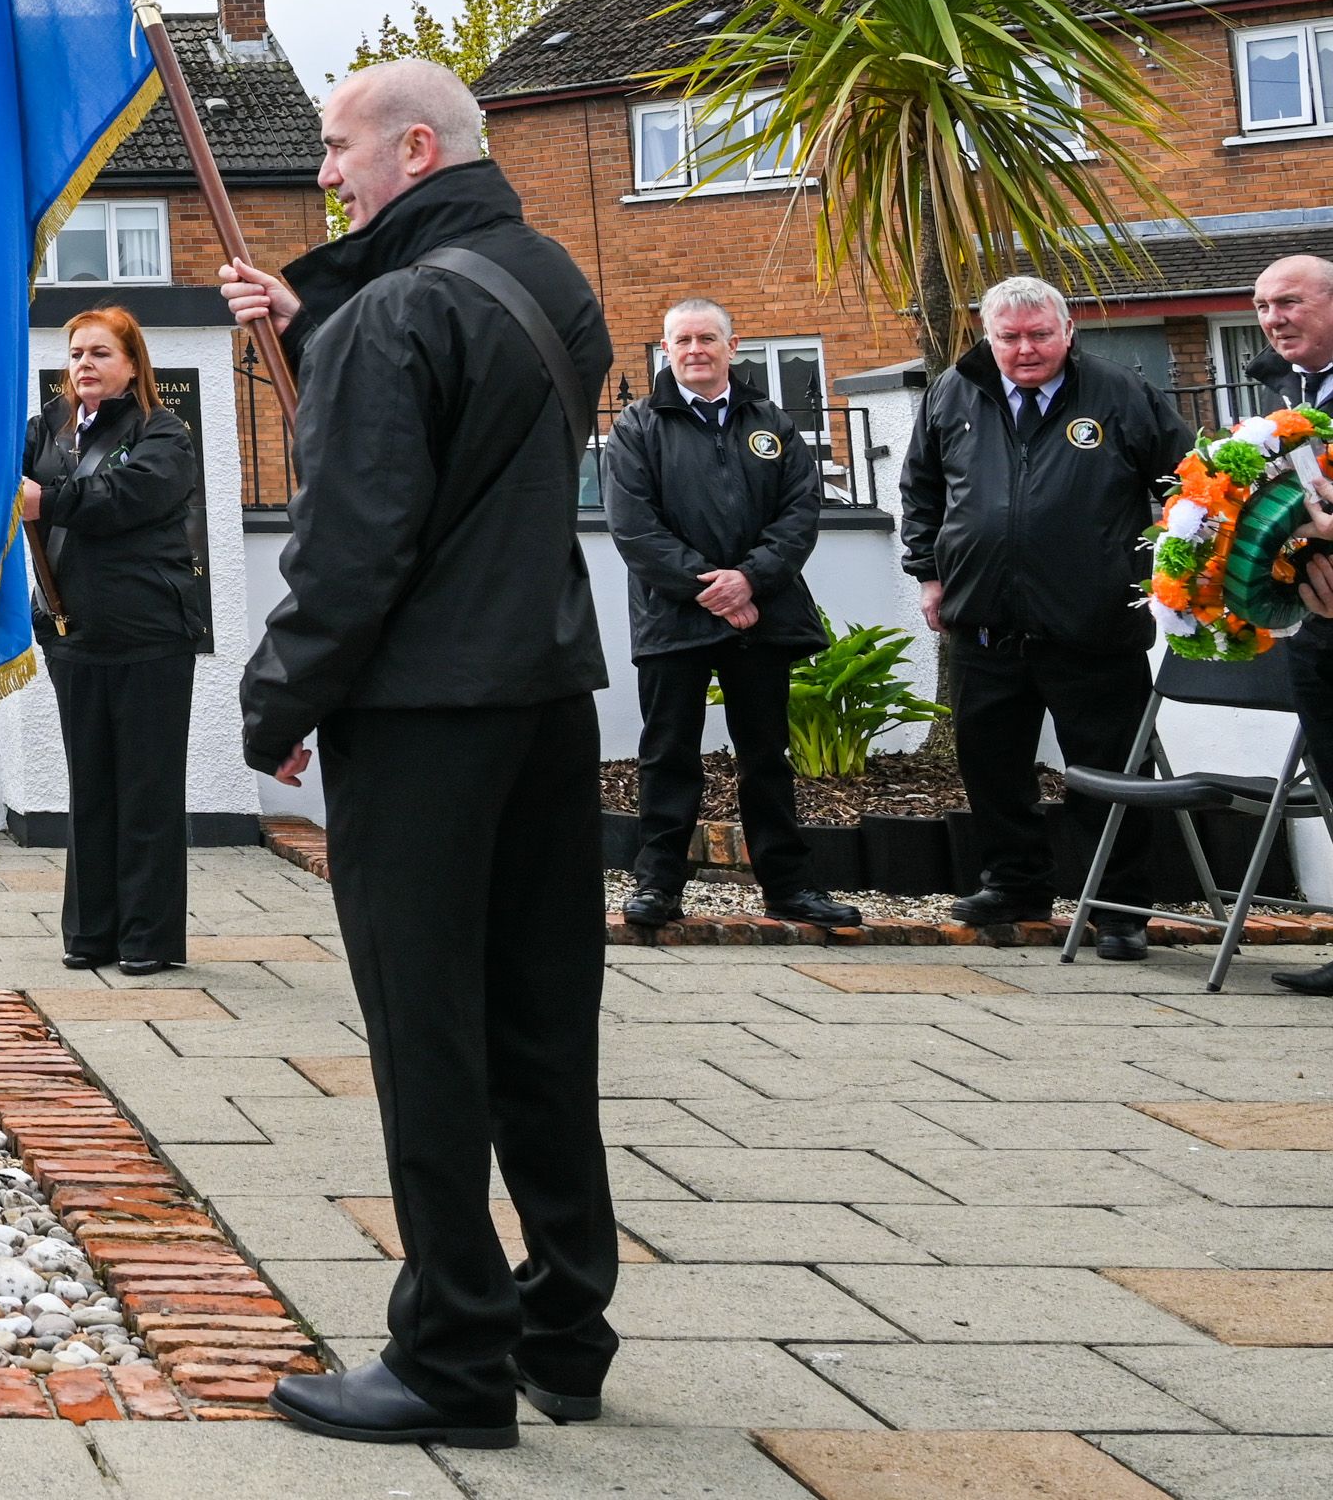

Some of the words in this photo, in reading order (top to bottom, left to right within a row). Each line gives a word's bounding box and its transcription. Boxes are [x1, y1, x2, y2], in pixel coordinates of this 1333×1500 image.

[49, 383, 64, 394] Vol
[155, 382, 191, 393] GHAM
[160, 395, 181, 405] vice
